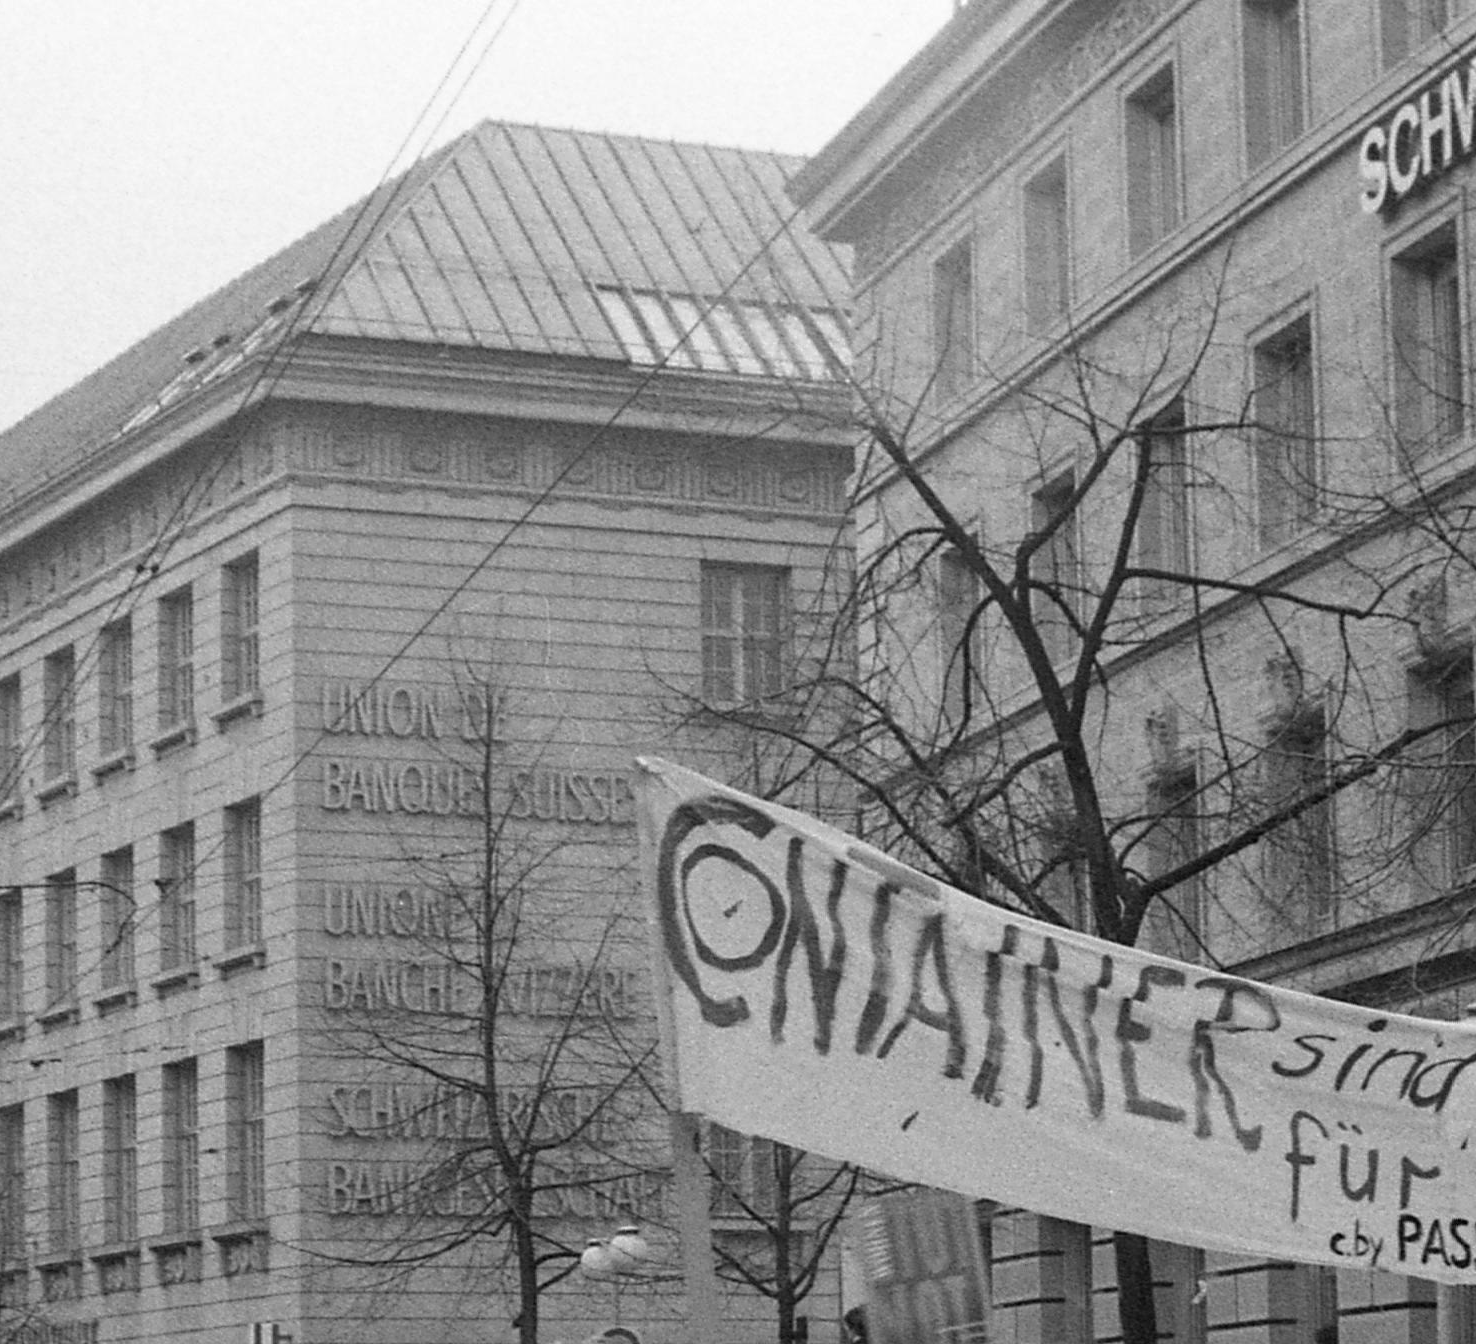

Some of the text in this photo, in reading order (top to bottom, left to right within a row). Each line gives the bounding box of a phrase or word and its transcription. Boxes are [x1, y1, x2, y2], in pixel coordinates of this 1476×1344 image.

[322, 682, 441, 739] UNION
[322, 760, 486, 820] BANQUE
[657, 796, 1280, 1151] CONTAINER
[1284, 1110, 1441, 1222] für
